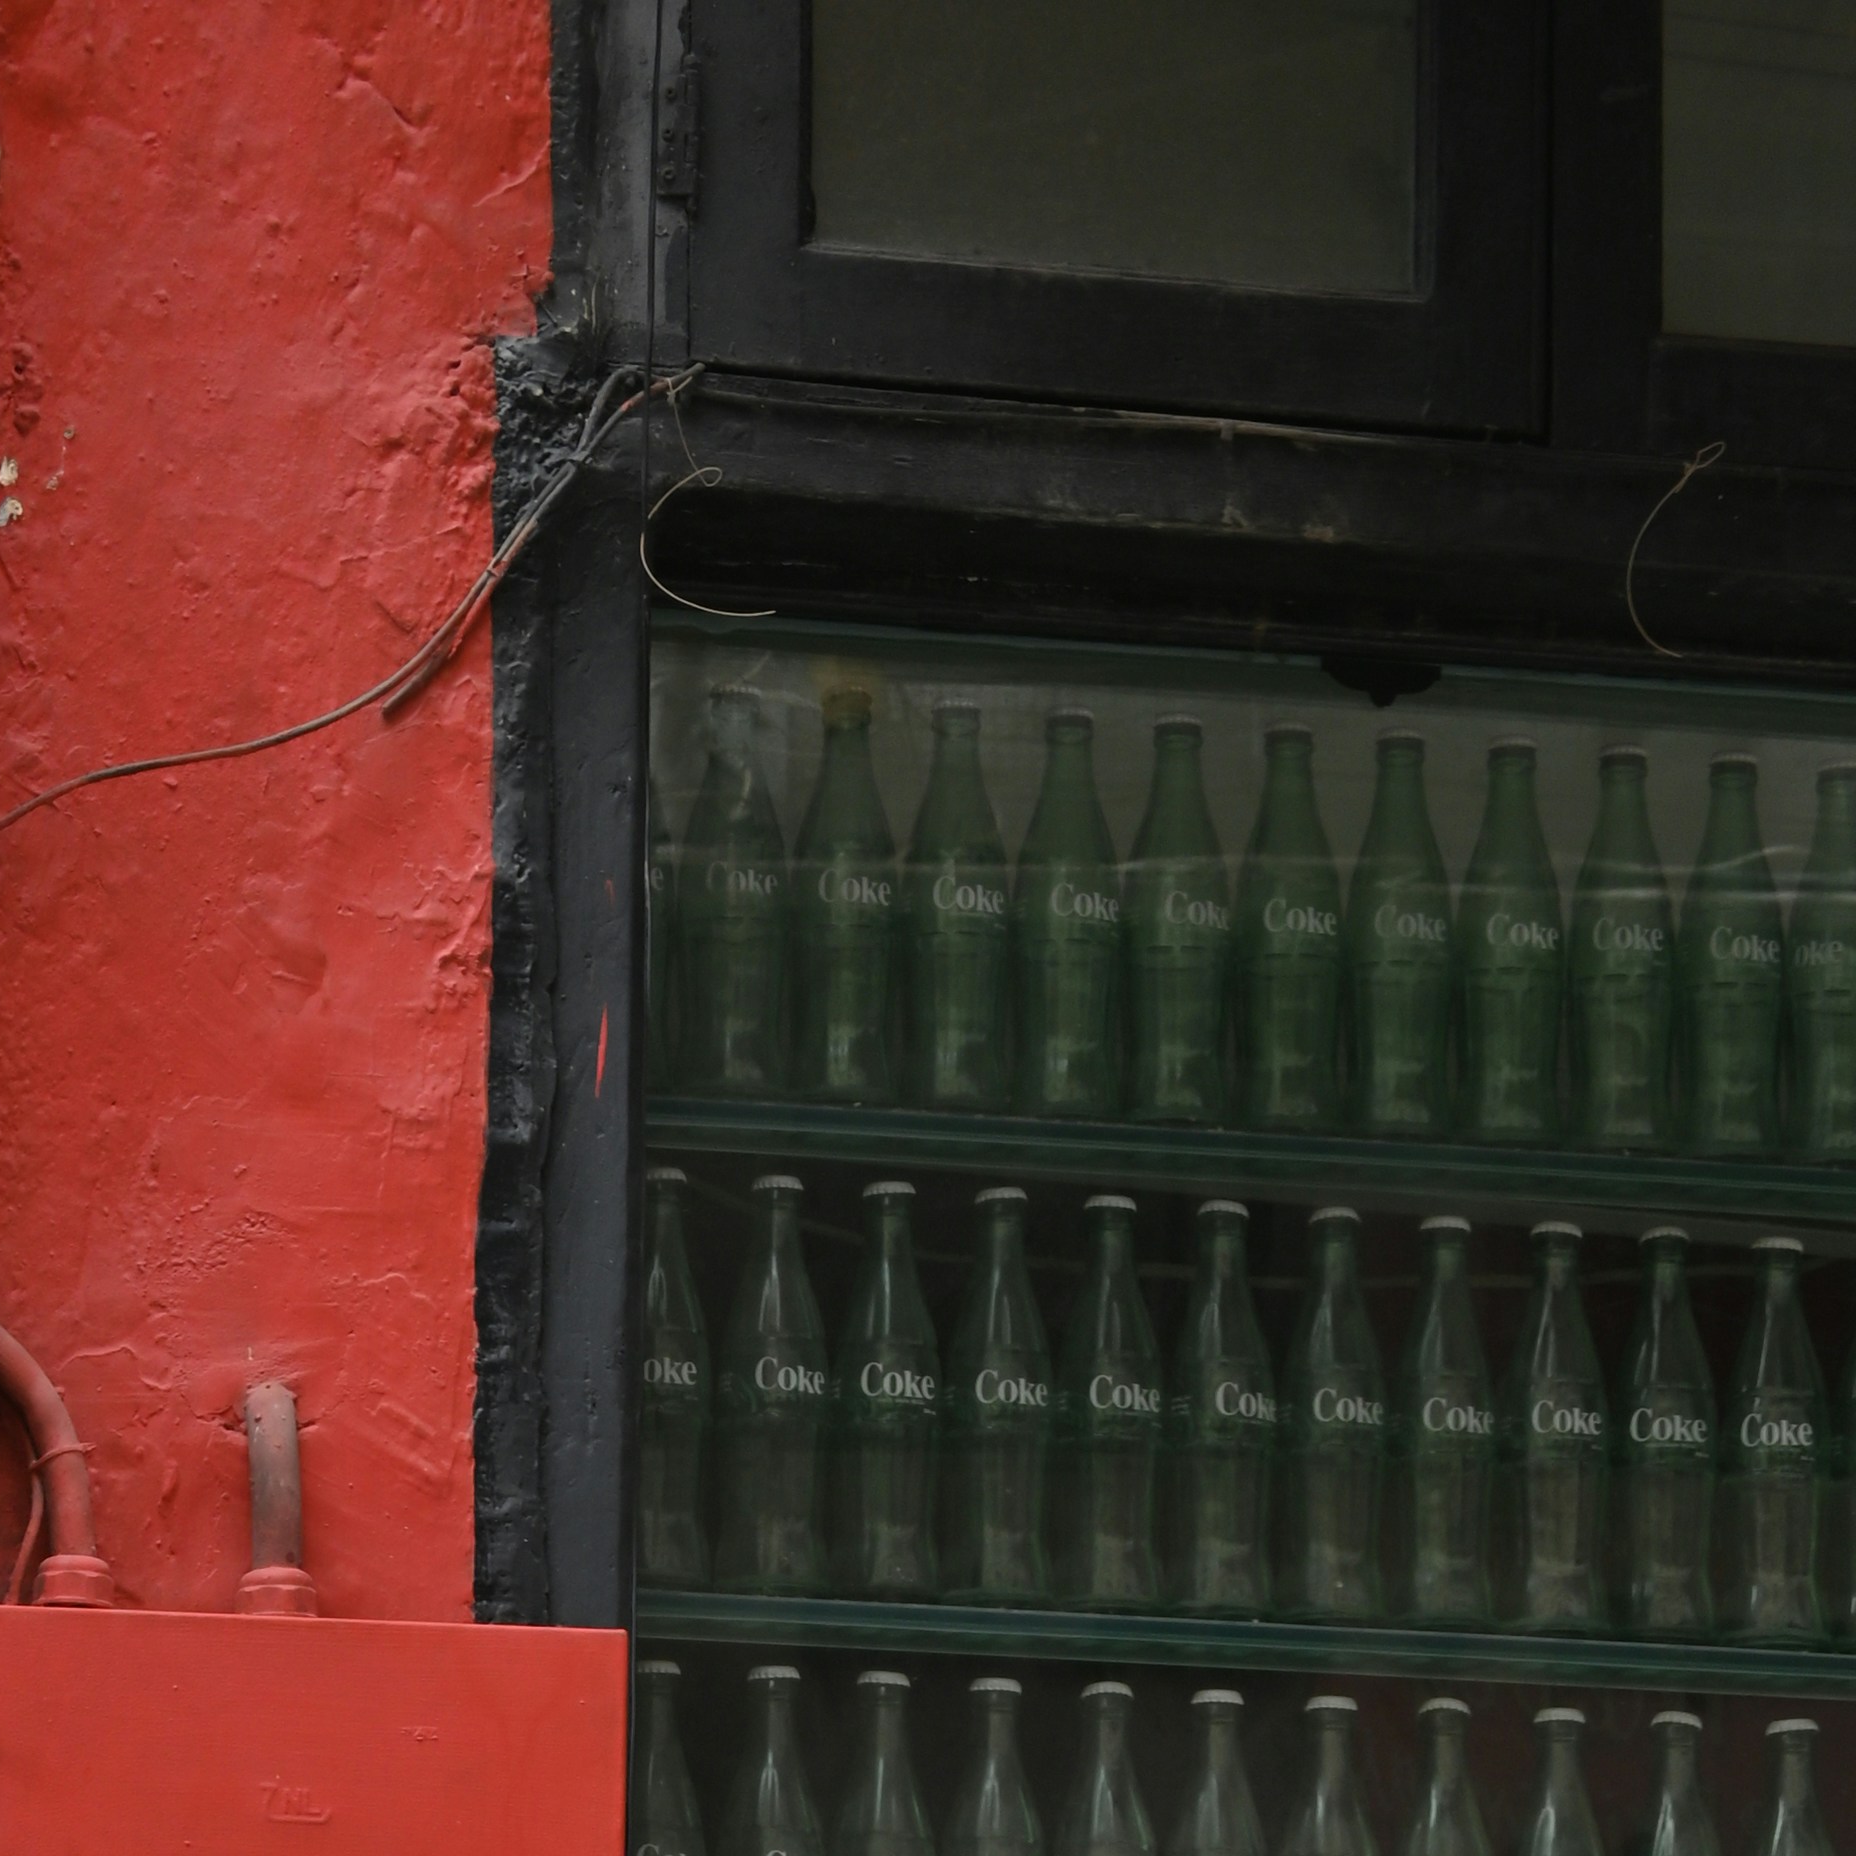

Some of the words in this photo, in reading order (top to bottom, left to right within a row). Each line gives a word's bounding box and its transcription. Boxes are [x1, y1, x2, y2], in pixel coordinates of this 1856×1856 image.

[707, 861, 778, 896] Coke
[818, 868, 891, 906] Coke
[933, 874, 1005, 914] Coke
[1051, 882, 1119, 922] Coke
[1263, 898, 1337, 935] Coke
[1375, 904, 1446, 942] Coke
[1487, 914, 1559, 950] Coke
[1593, 917, 1663, 952] Coke
[1710, 926, 1780, 961] Coke
[644, 1358, 697, 1385] oke
[755, 1357, 825, 1395] Coke
[860, 1362, 935, 1400] Coke
[975, 1368, 1048, 1407] Coke
[1090, 1375, 1160, 1413] Coke
[1313, 1388, 1383, 1424] Coke
[1531, 1400, 1602, 1435] Coke
[1630, 1408, 1707, 1442] Coke
[1741, 1413, 1812, 1446] Coke
